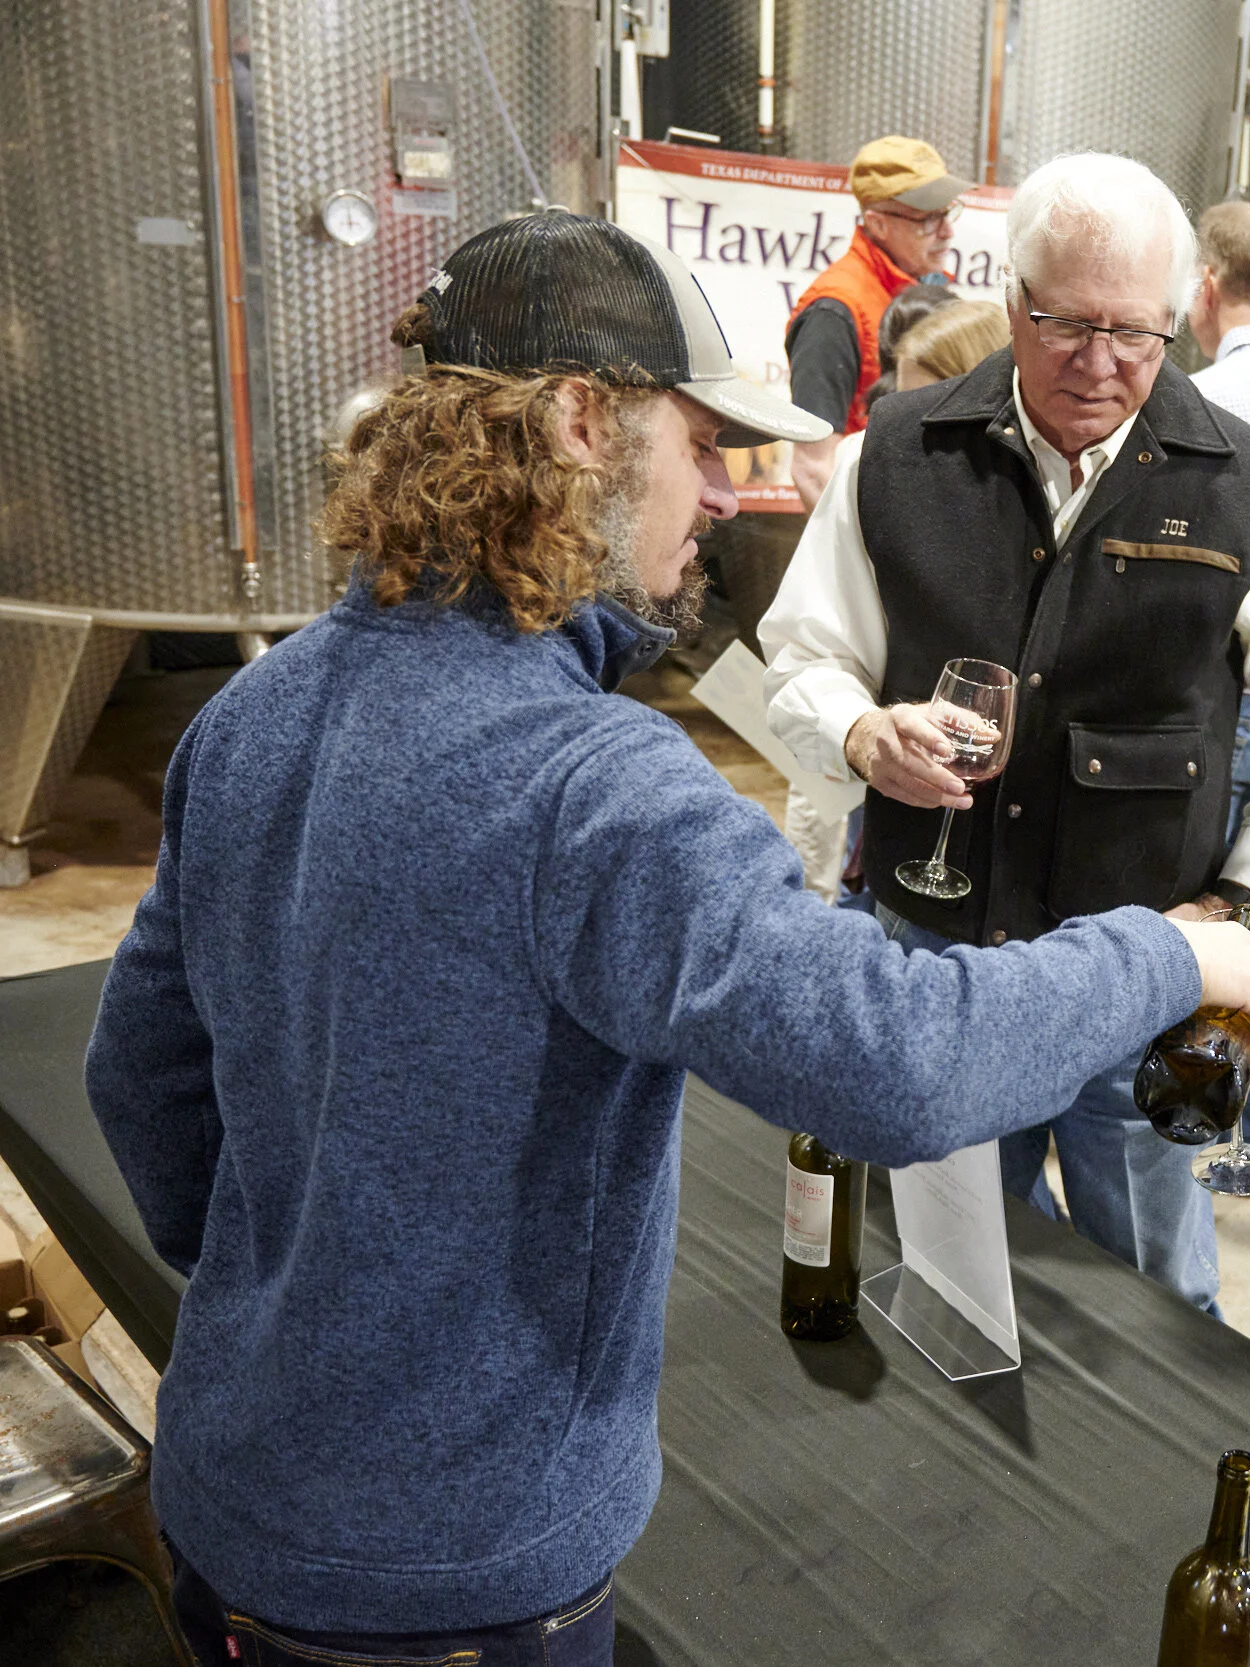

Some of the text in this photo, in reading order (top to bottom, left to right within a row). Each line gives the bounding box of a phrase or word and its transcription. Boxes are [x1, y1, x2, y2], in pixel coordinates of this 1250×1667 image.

[701, 163, 741, 177] TEXAS
[743, 167, 824, 188] DEPARTMENT
[826, 178, 842, 190] OF
[659, 196, 863, 270] Hawk
[1161, 518, 1189, 537] JOE
[955, 730, 970, 739] AND
